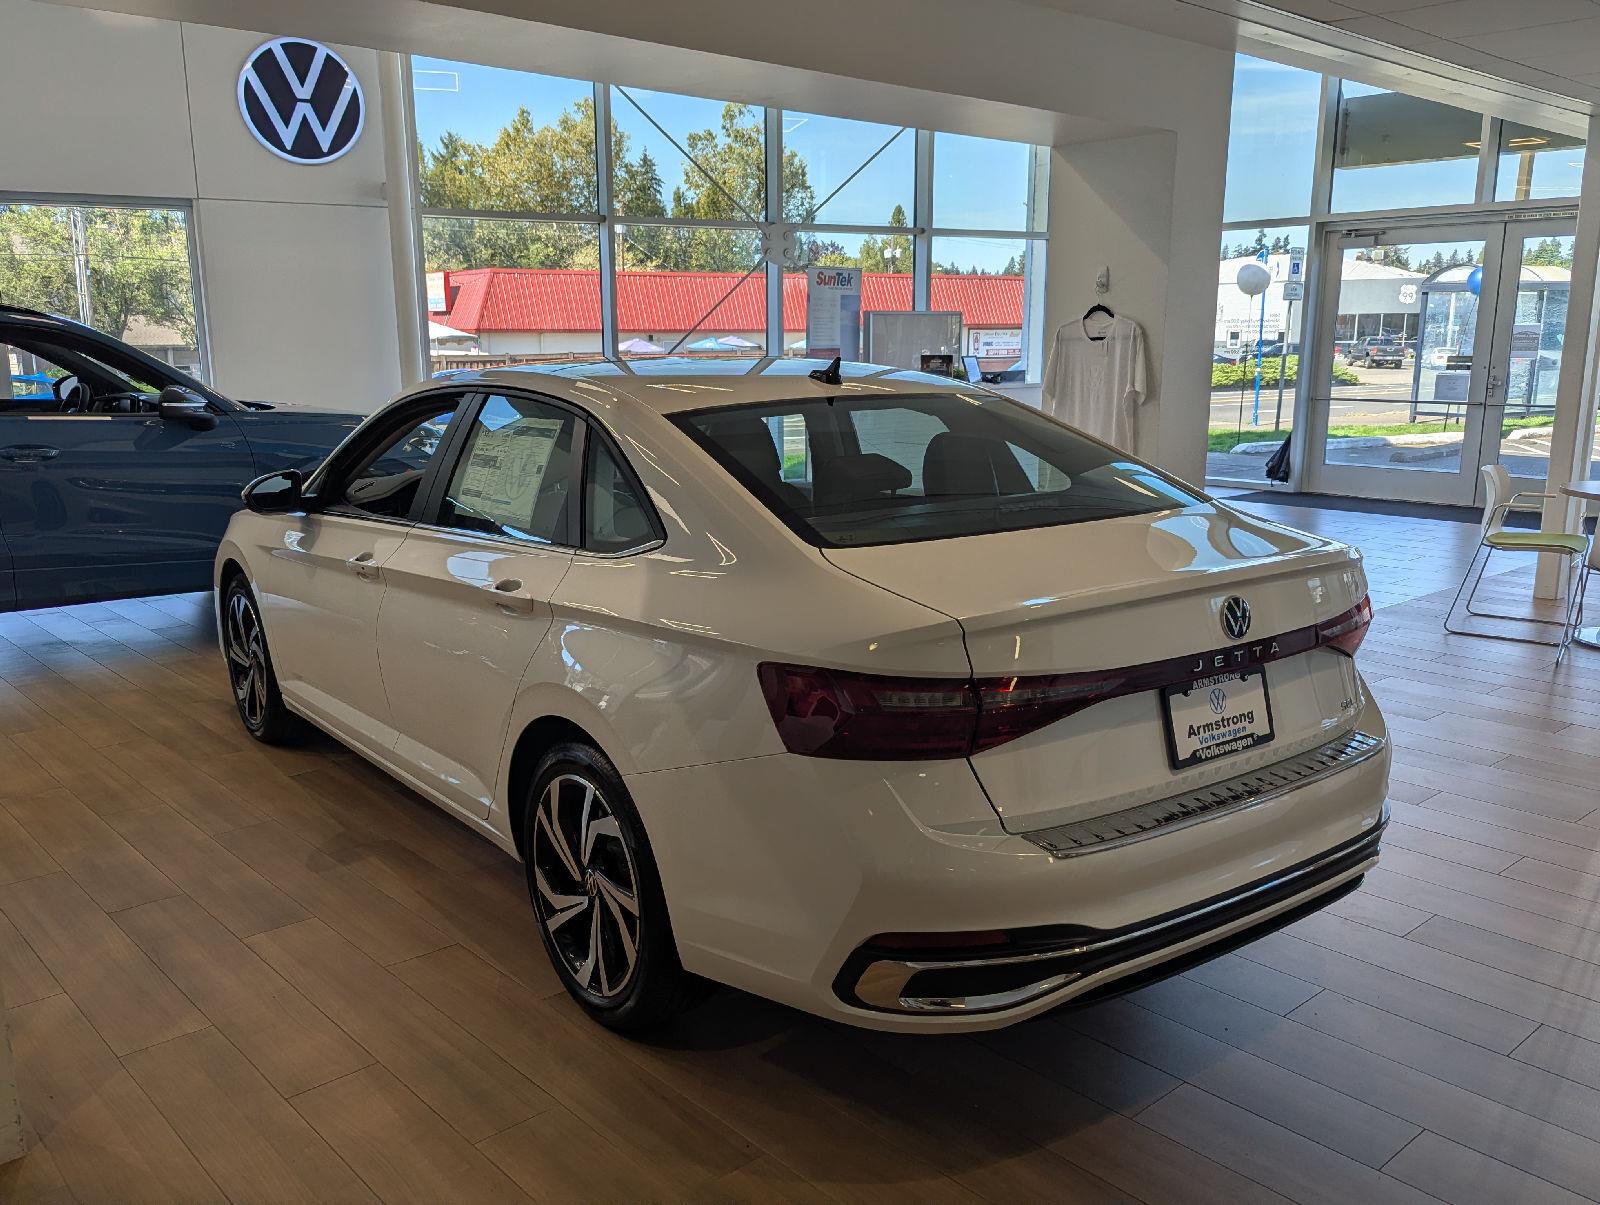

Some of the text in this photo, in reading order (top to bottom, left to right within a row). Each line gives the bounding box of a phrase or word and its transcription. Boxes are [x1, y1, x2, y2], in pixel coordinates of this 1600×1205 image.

[240, 38, 364, 164] VW
[816, 271, 853, 287] SunTek
[1222, 595, 1250, 639] VW
[1193, 642, 1280, 672] JETTA
[1192, 672, 1241, 690] ARMSTRONG
[1187, 709, 1255, 739] Armstrong
[1198, 725, 1247, 746] Volkswagen
[1199, 737, 1253, 760] Volkswagen
